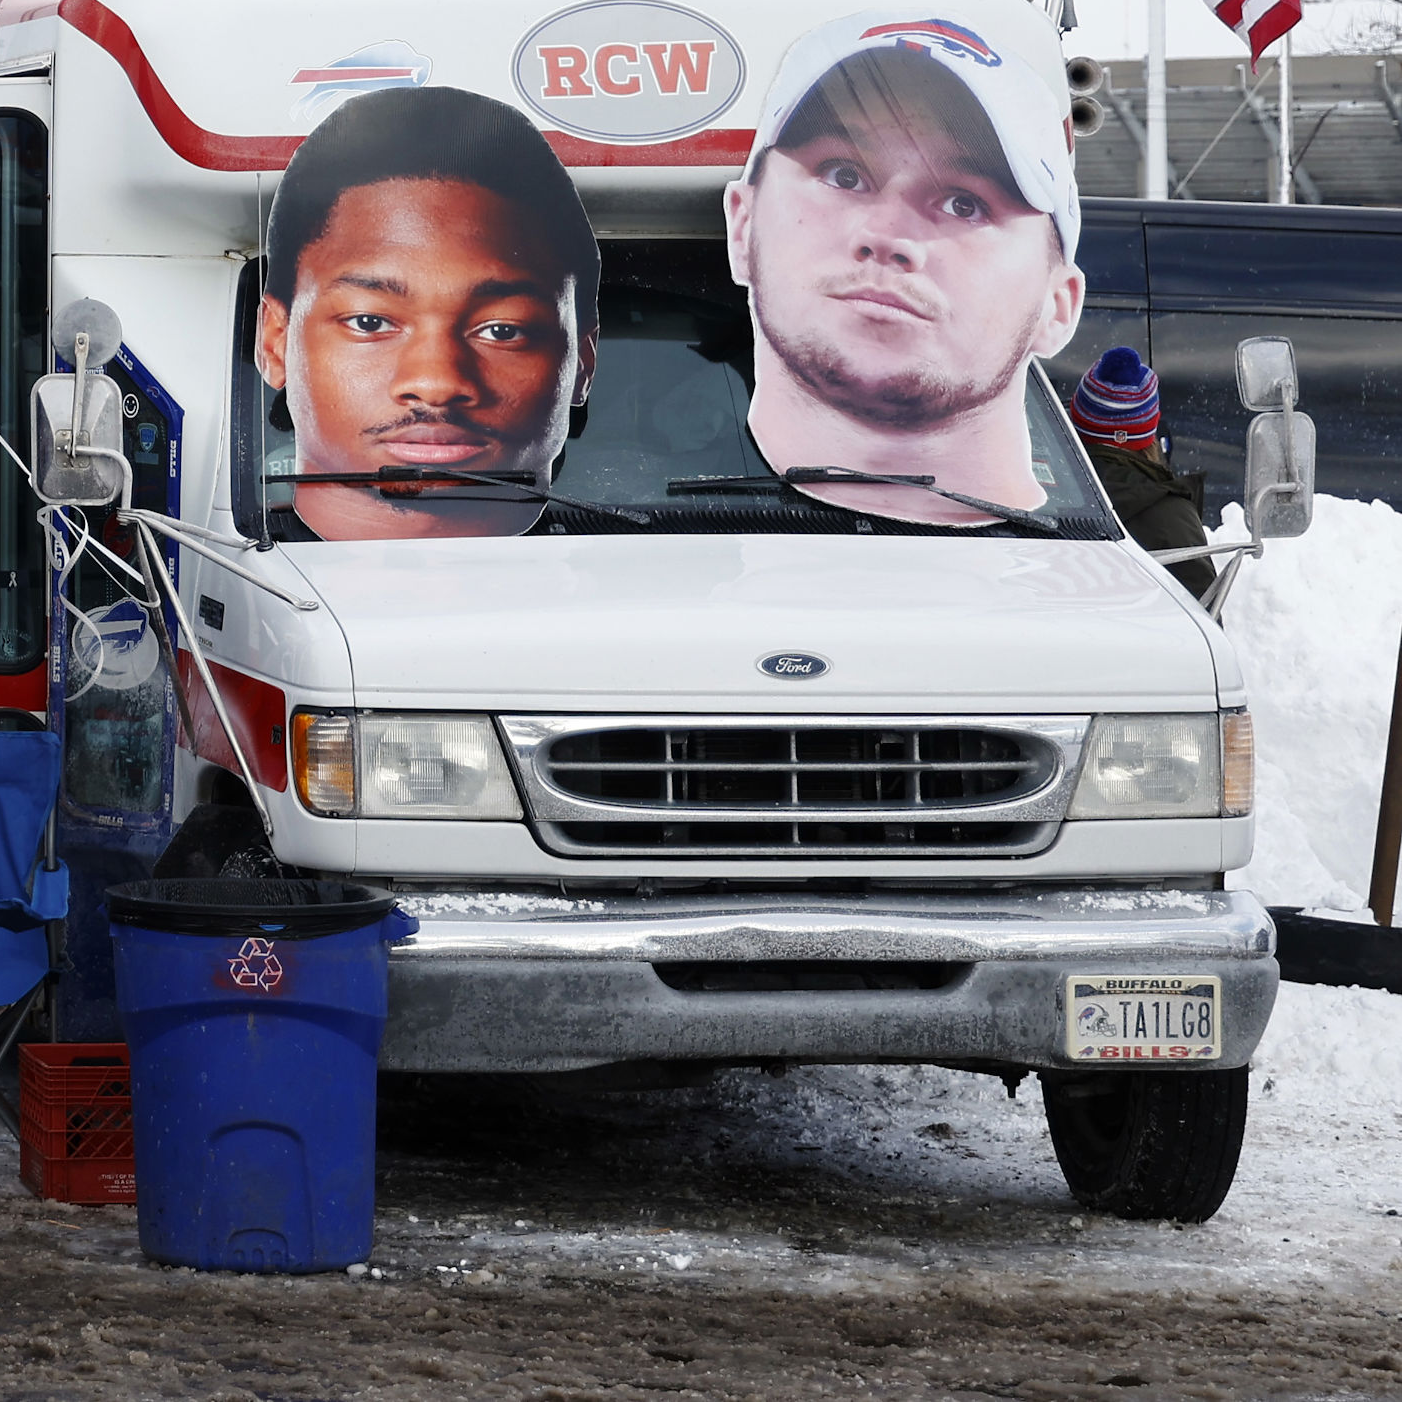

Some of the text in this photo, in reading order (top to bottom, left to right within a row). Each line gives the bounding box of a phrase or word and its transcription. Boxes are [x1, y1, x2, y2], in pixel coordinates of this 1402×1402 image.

[537, 41, 716, 98] RCW
[52, 645, 61, 683] BILLS
[775, 657, 812, 673] Ford
[1106, 979, 1183, 989] BUFFALO
[1100, 1045, 1189, 1059] BILLS
